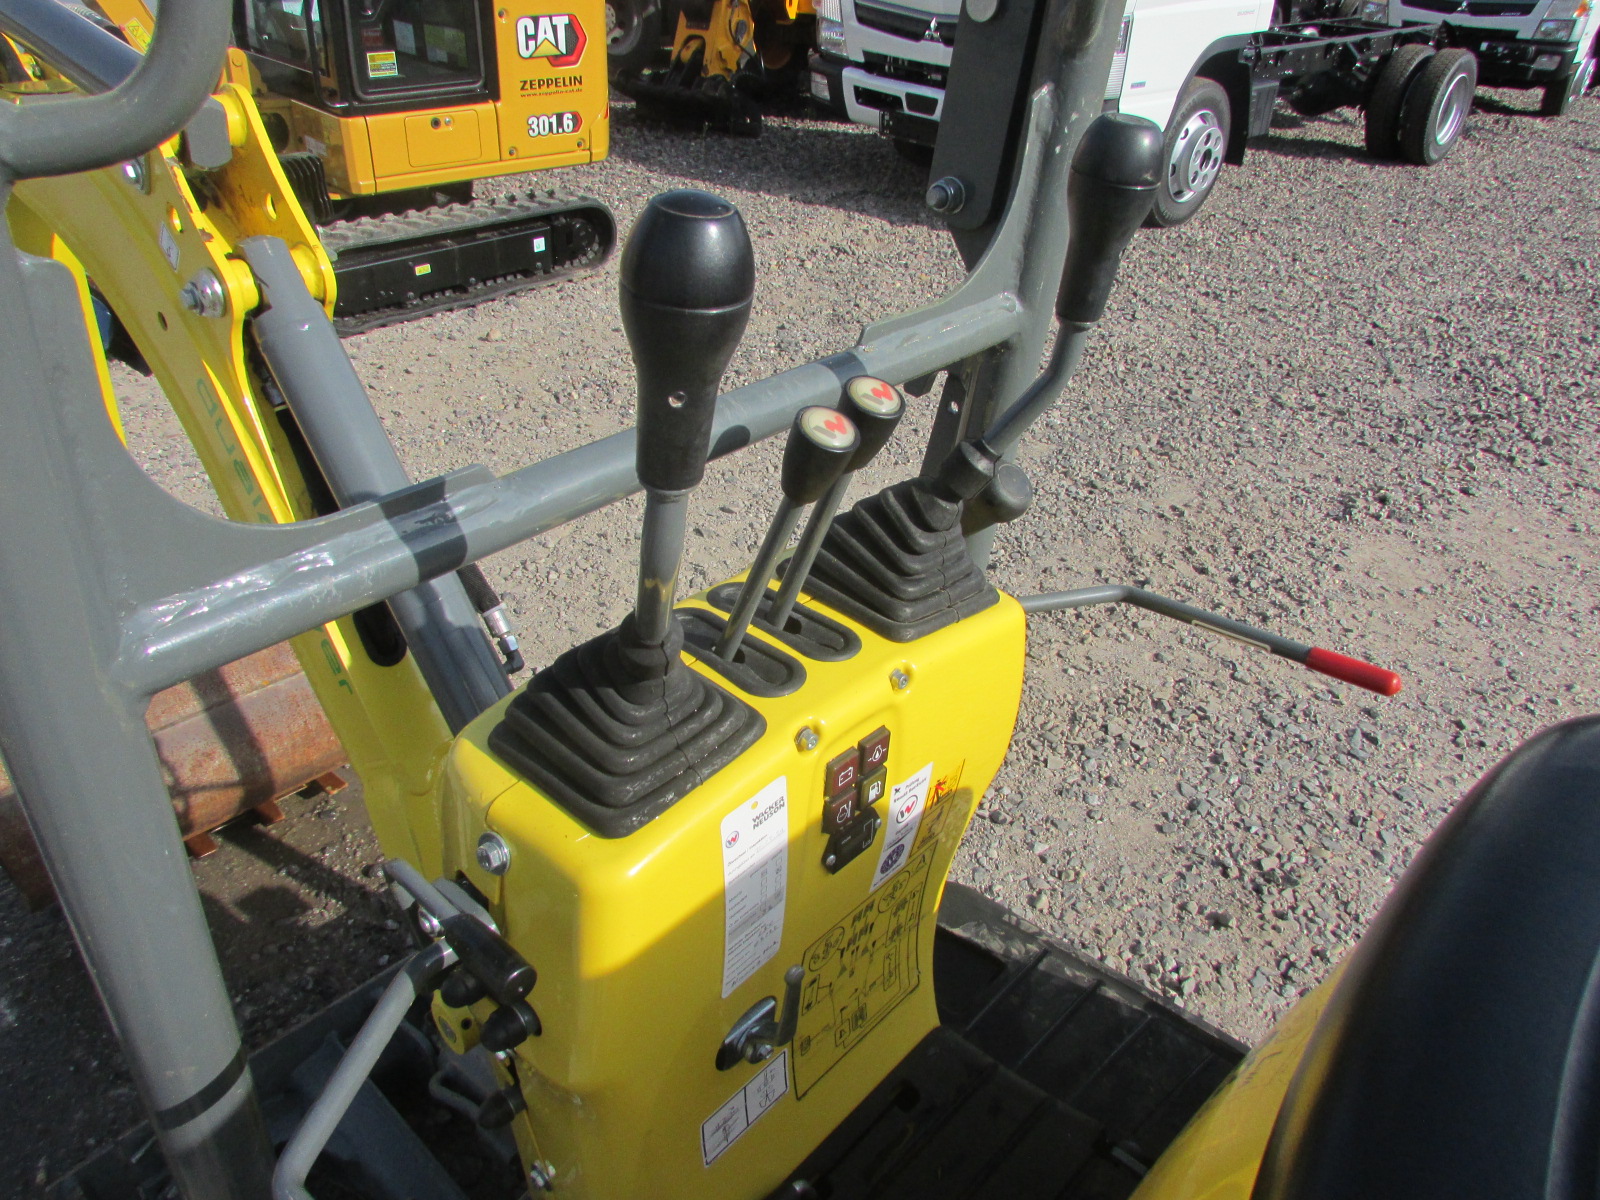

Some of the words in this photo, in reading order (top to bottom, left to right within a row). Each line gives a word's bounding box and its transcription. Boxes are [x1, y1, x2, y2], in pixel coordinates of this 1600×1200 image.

[517, 15, 569, 58] CAT
[520, 75, 583, 91] ZEPPELIN
[520, 87, 583, 98] www.zeppelin-cat.de
[527, 112, 574, 137] 301.6
[752, 796, 784, 823] WACKER
[753, 801, 785, 831] NEUSON
